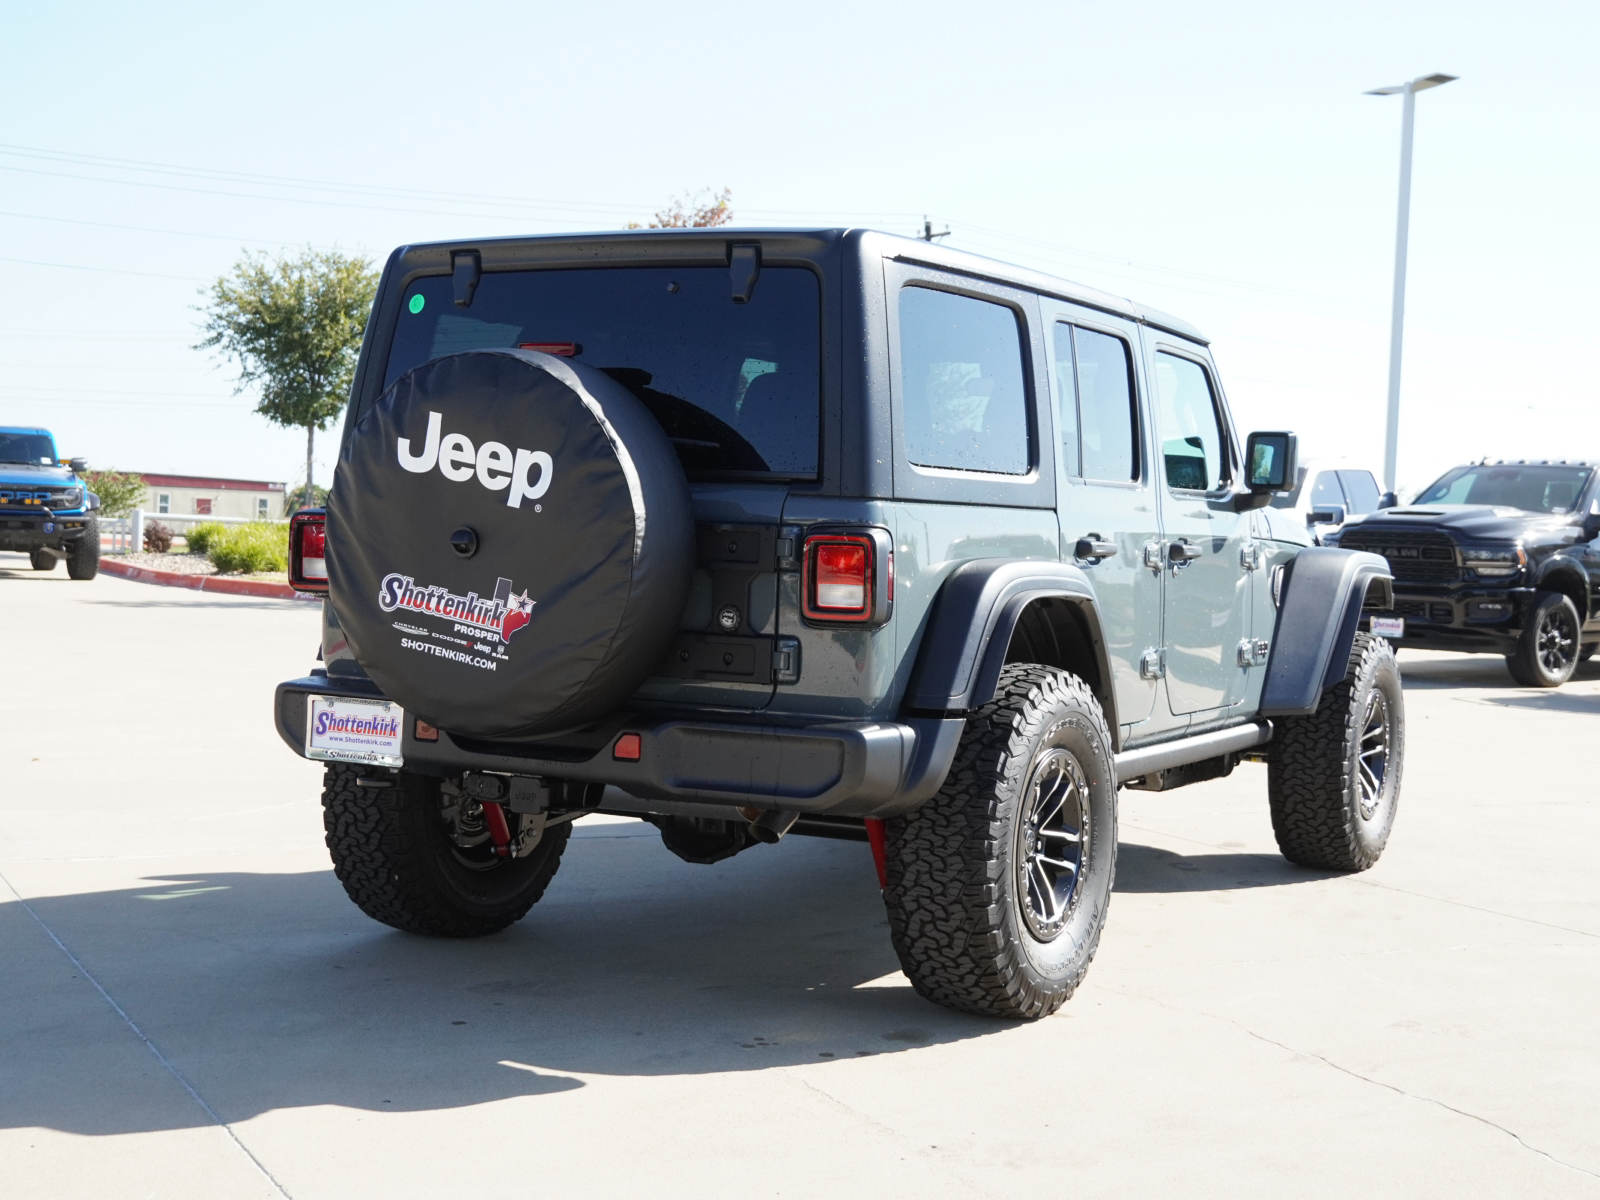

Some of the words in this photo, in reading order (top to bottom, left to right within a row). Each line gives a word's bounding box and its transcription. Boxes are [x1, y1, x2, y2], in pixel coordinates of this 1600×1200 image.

[397, 410, 554, 509] Jeep
[0, 490, 53, 501] ORD
[380, 574, 508, 631] Shottenkirk
[394, 621, 428, 632] CHRYSLER
[431, 632, 468, 645] DODGE
[474, 641, 491, 654] Jeep
[454, 623, 500, 642] PROSPER
[401, 637, 497, 671] SHOTTENKIRK.COM
[315, 711, 399, 737] Shottenkirk
[329, 736, 392, 747] www.Shottenkirk.com
